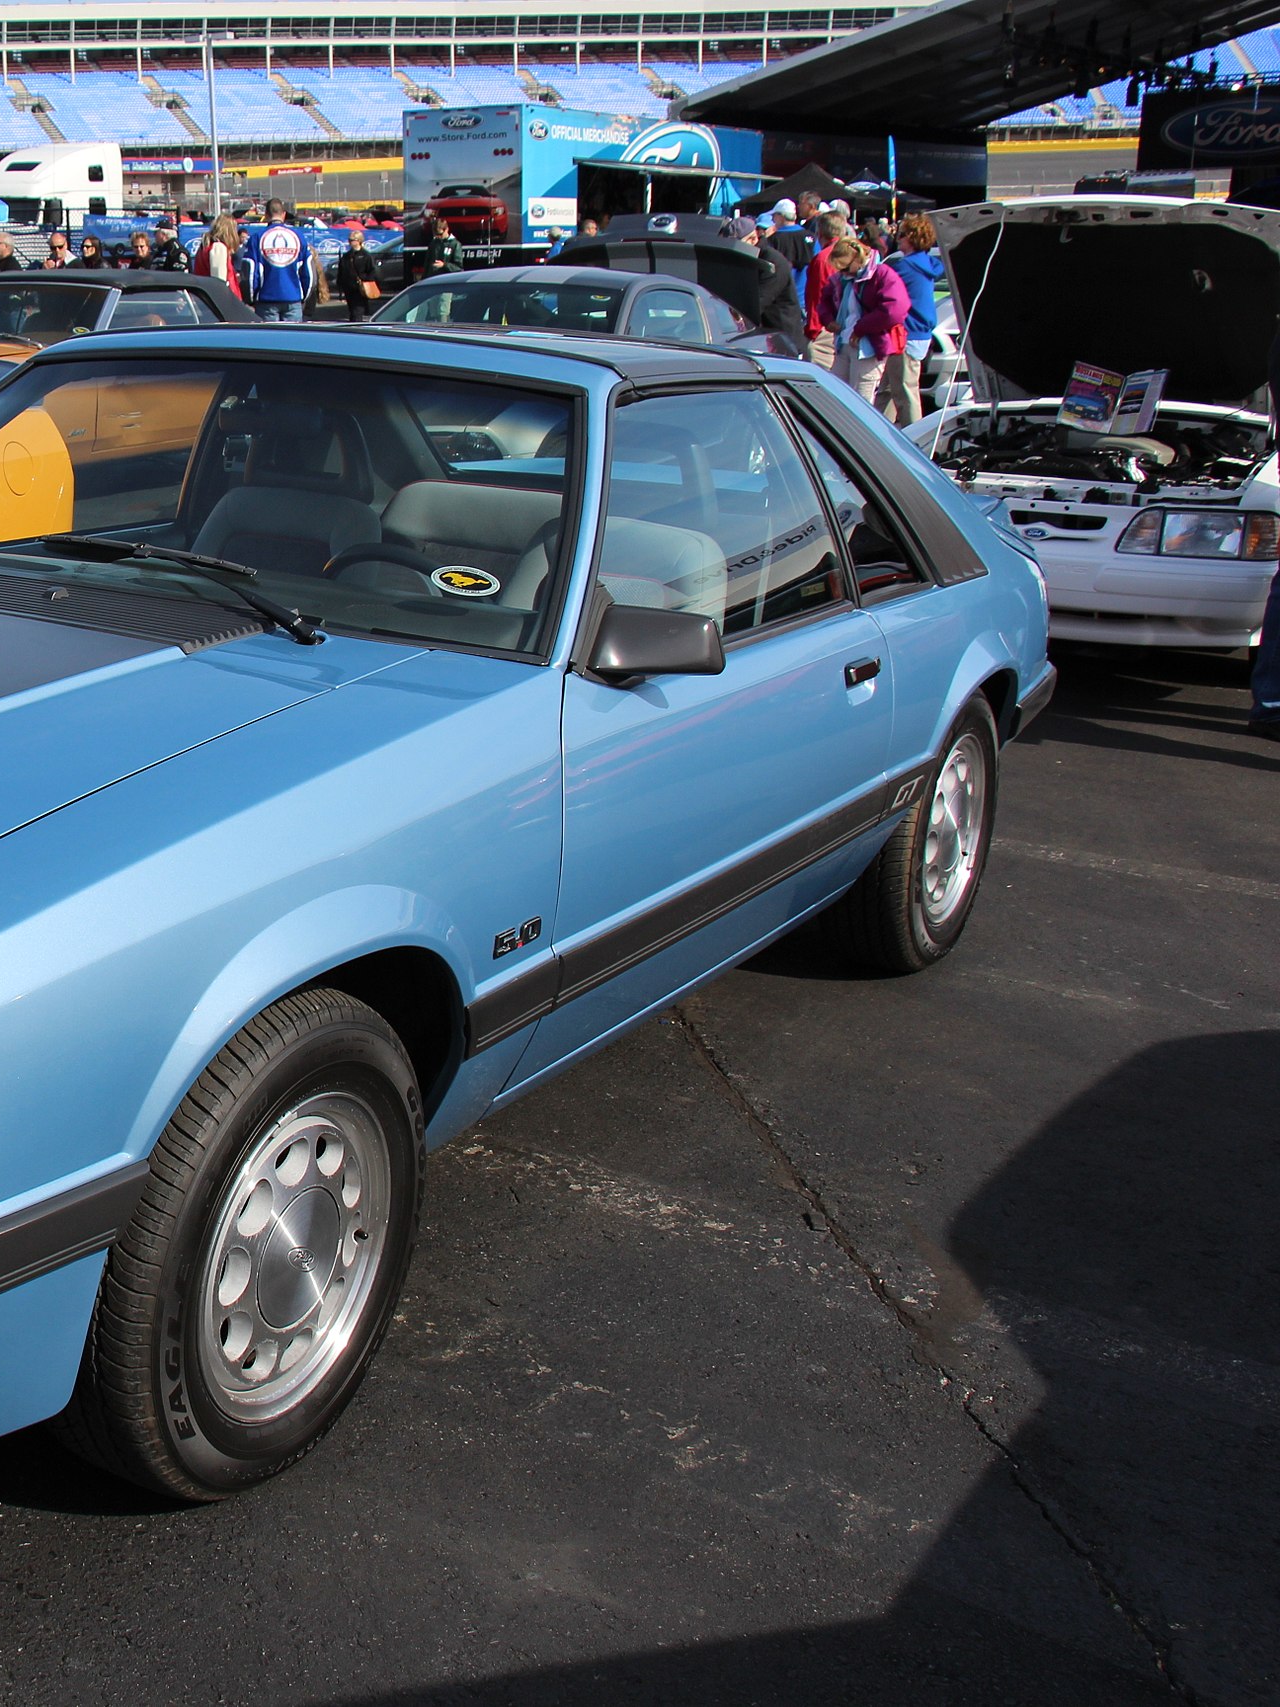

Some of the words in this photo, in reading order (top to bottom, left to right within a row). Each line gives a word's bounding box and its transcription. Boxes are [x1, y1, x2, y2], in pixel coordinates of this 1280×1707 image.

[418, 131, 507, 143] www.Store.Ford.com
[551, 124, 583, 140] OFFICIAL
[583, 128, 629, 145] MERCHANDISE
[891, 775, 925, 810] GT
[493, 916, 542, 960] 5.0
[165, 1263, 197, 1441] EAGLE
